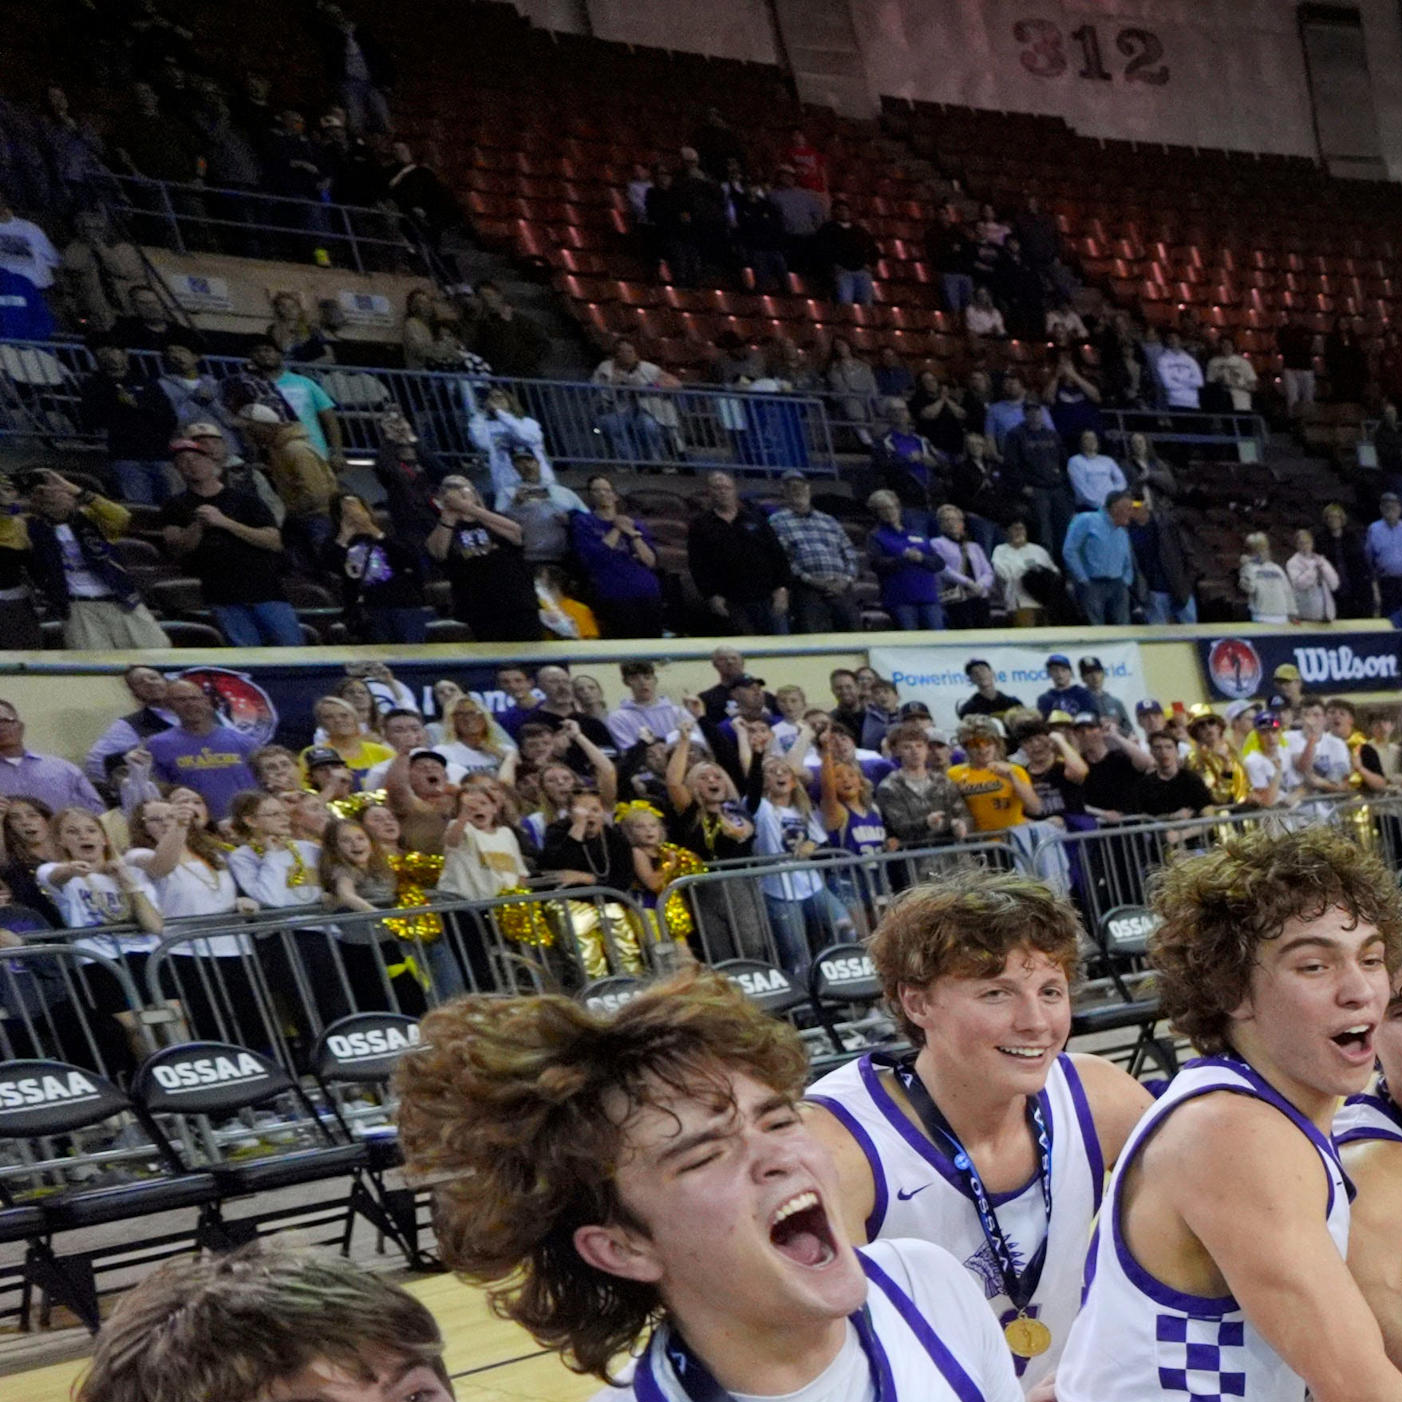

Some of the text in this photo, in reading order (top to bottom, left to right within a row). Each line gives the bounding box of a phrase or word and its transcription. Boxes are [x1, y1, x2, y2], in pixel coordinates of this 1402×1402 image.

[1013, 18, 1170, 86] 312
[1012, 671, 1050, 682] mod
[1102, 664, 1132, 679] rld.
[1294, 645, 1398, 682] Wilson
[727, 968, 789, 995] SAA
[820, 956, 881, 981] OSSA
[327, 1023, 421, 1059] OSSAA
[0, 1071, 97, 1107] SSAA
[152, 1052, 264, 1090] OSSAA
[969, 1176, 1008, 1272] OSSAA
